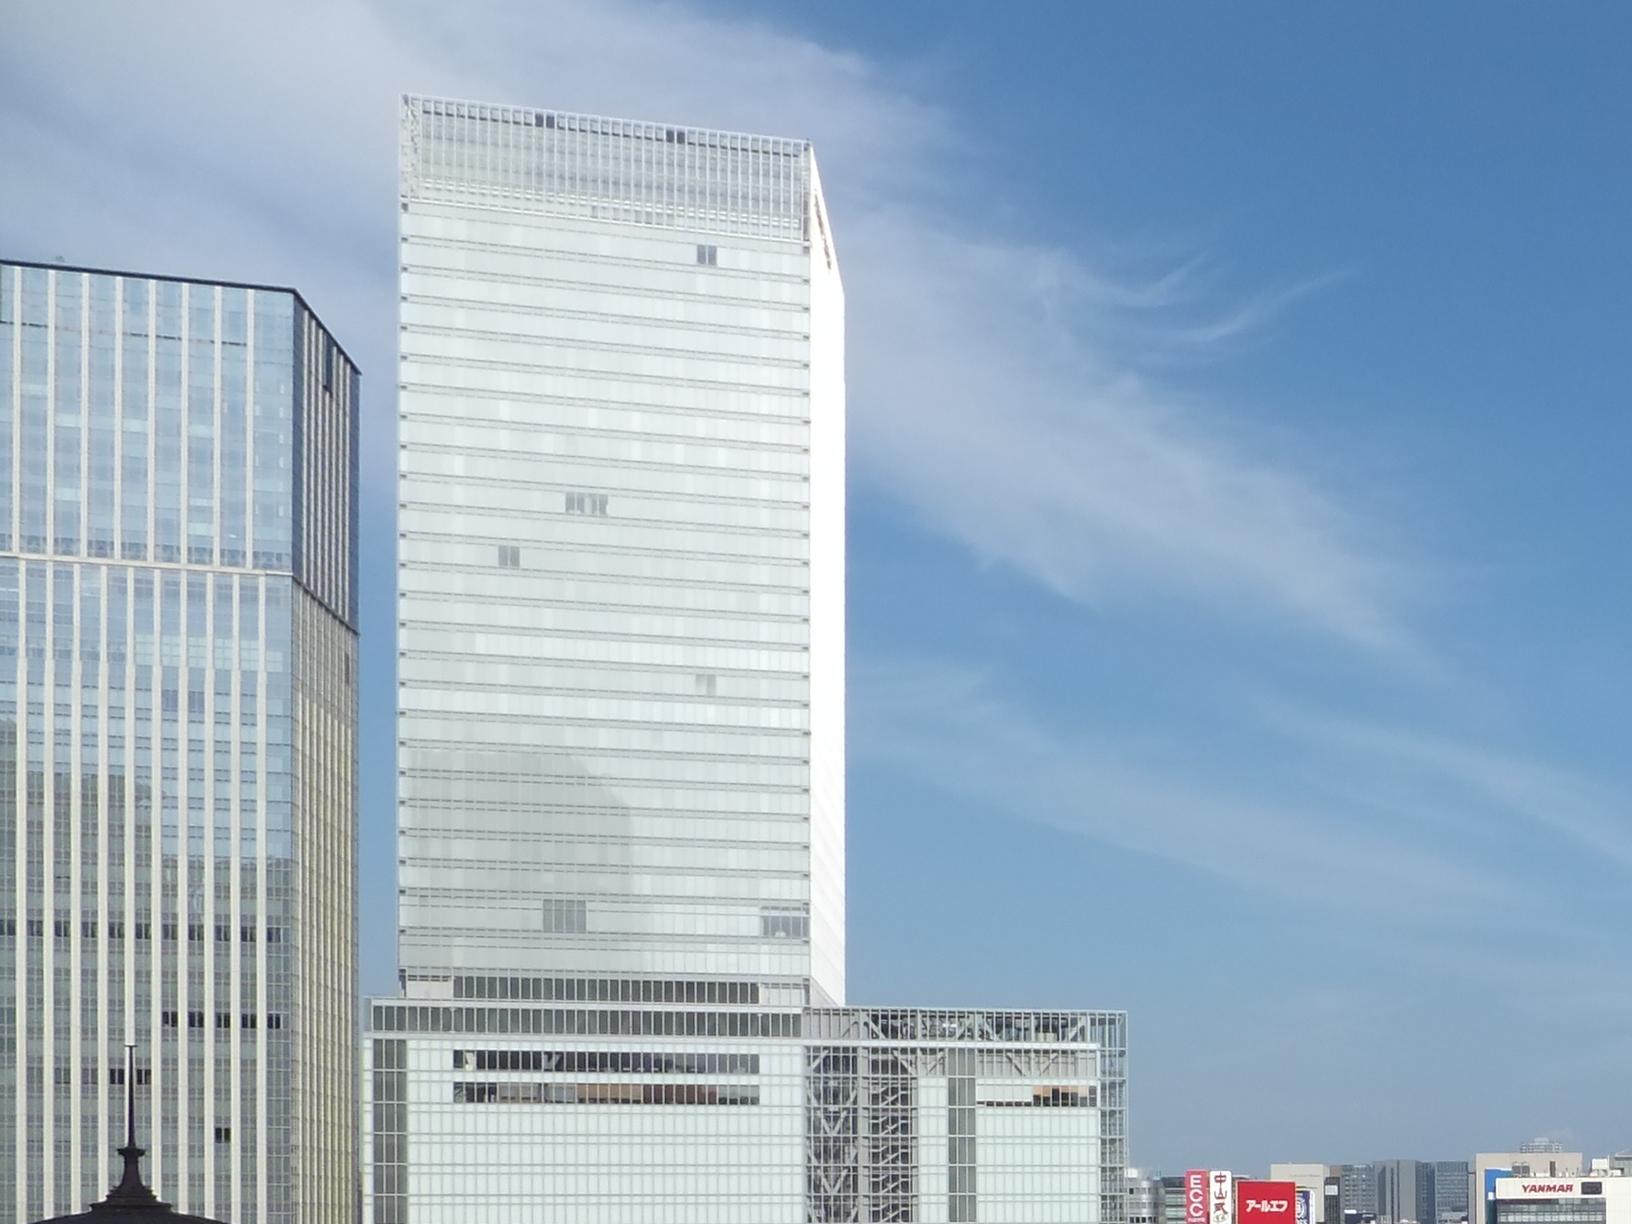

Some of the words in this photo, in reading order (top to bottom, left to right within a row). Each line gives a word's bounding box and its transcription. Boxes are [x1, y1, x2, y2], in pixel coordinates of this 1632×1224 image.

[1521, 1184, 1573, 1193] YANMAR
[1189, 1174, 1203, 1217] ECC
[1246, 1199, 1288, 1212] アールエフ
